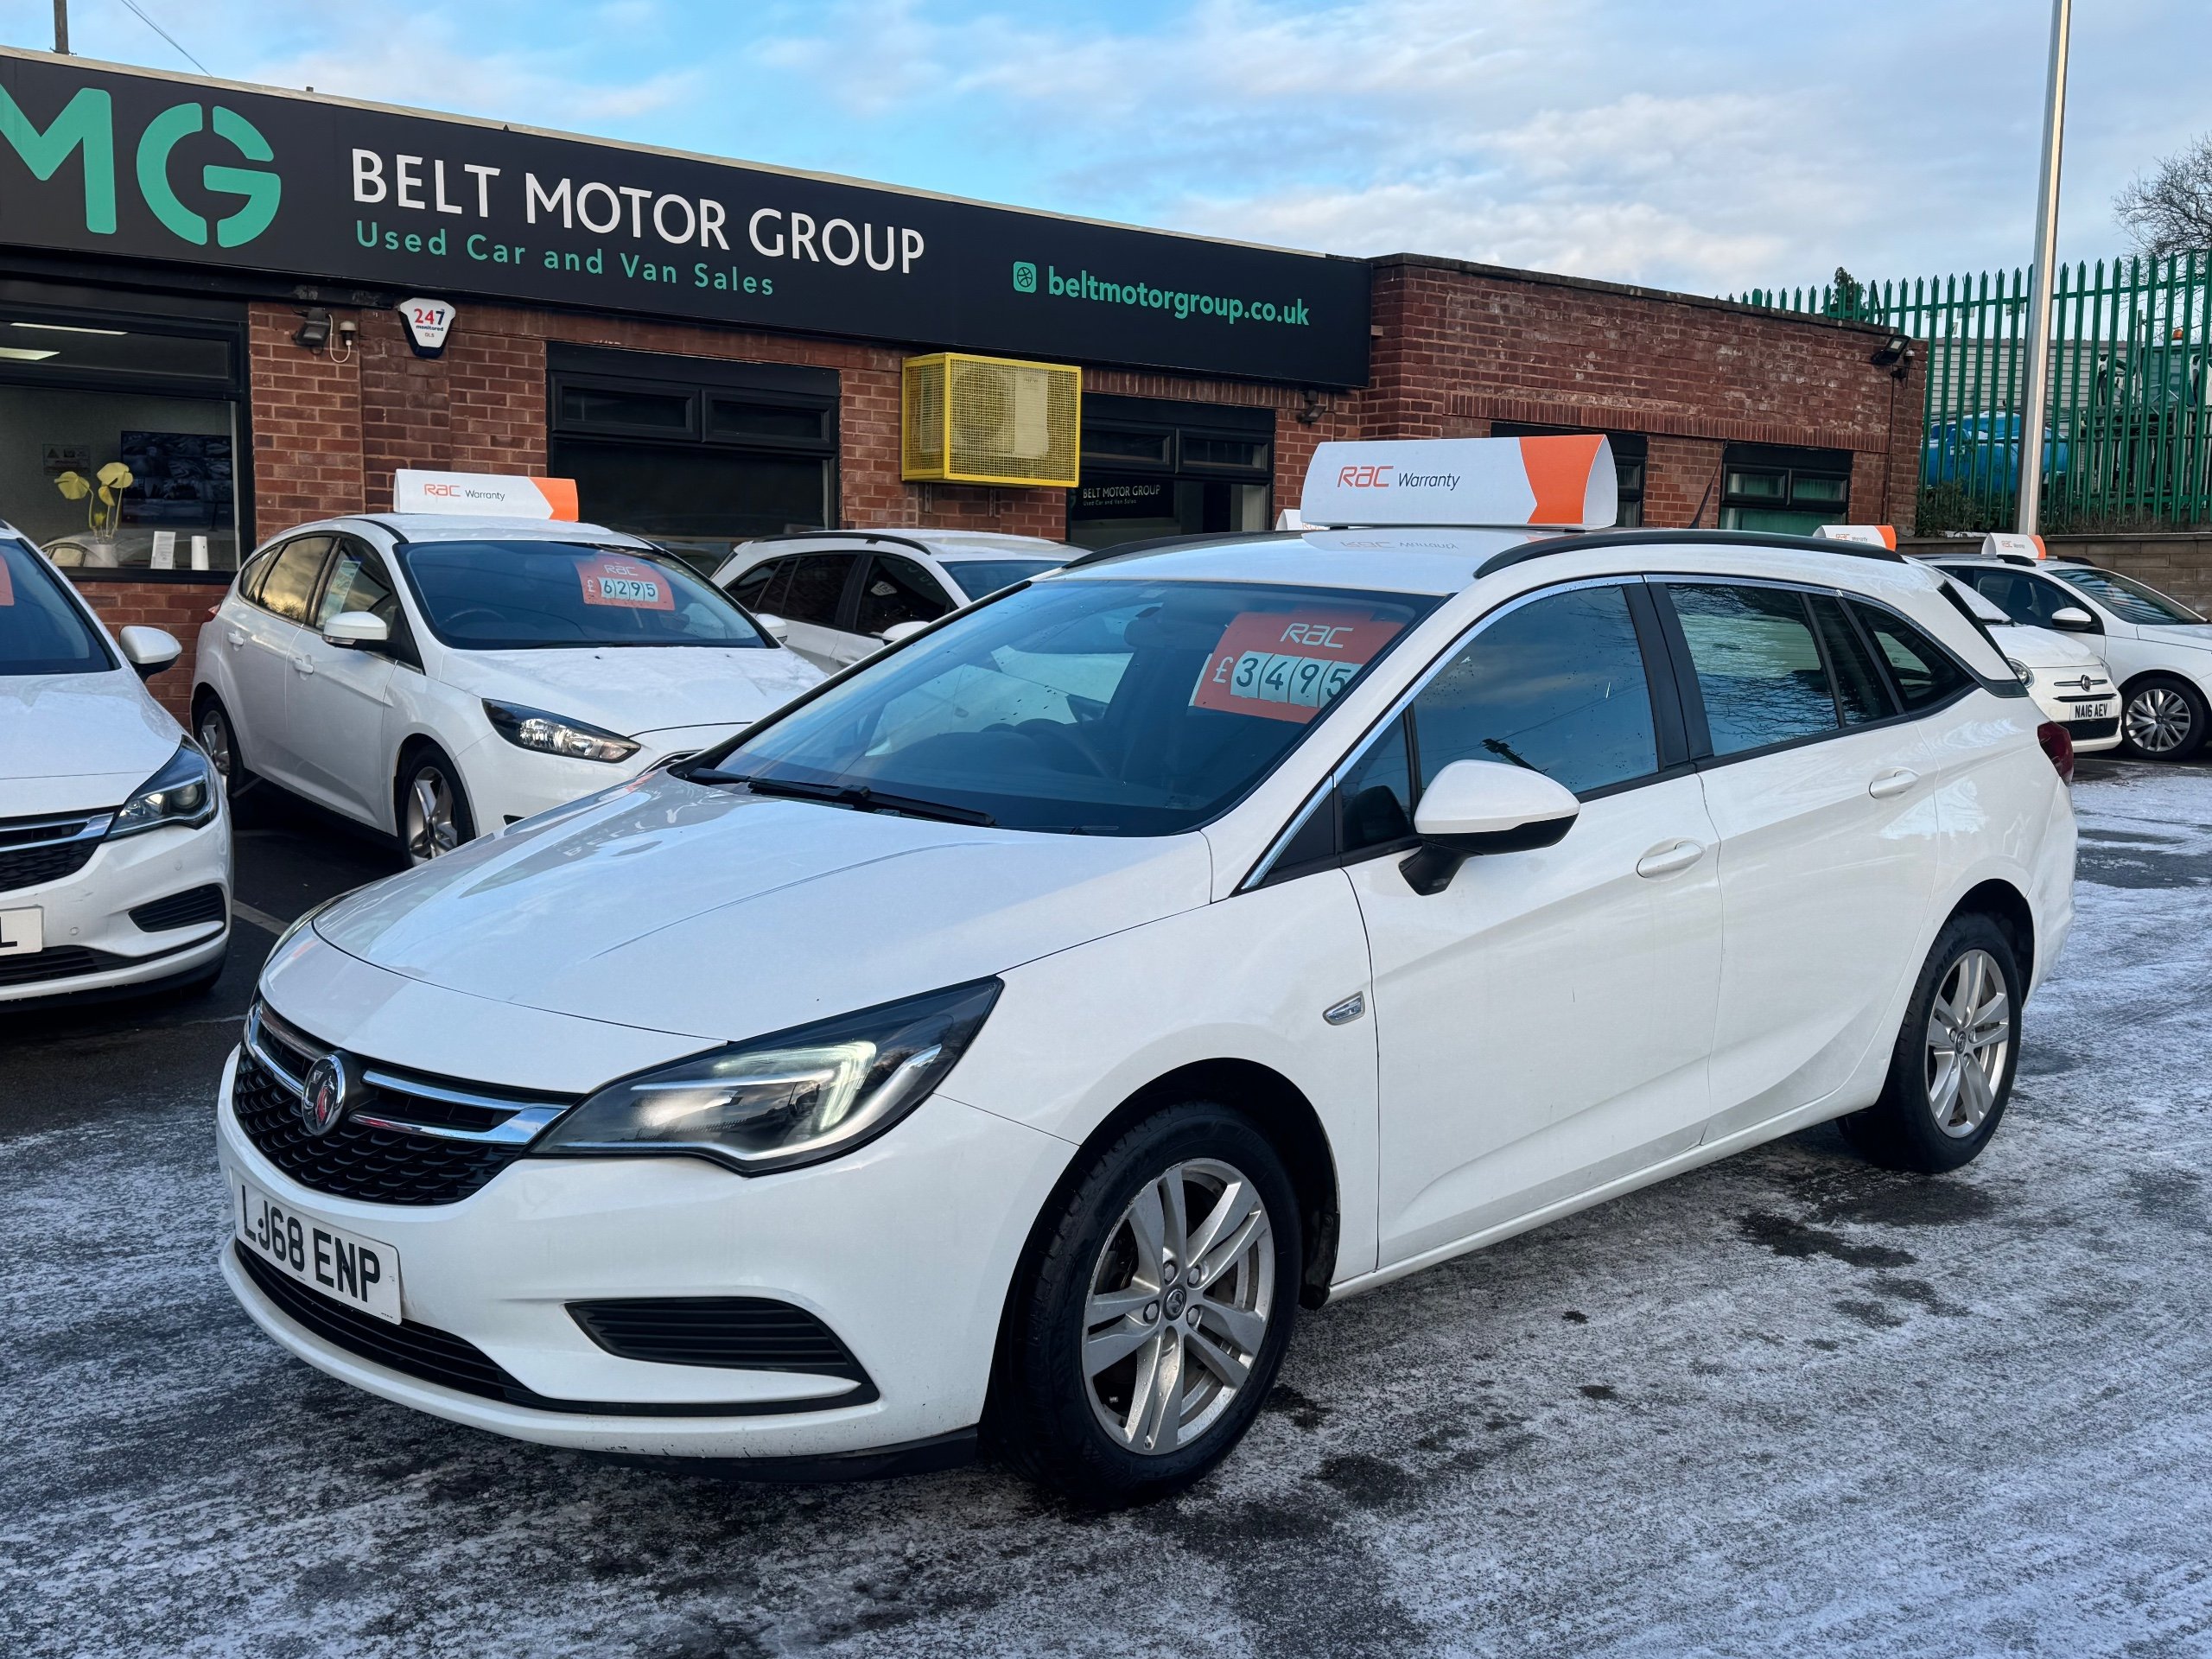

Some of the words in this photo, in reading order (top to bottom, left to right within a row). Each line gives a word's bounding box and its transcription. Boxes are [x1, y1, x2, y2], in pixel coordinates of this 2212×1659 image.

[352, 148, 501, 219] BELT
[525, 173, 730, 251] MOTOR
[748, 207, 925, 274] GROUP
[357, 219, 447, 256] Used
[467, 234, 525, 264] Car
[543, 249, 603, 275] and
[620, 252, 677, 283] Van
[694, 263, 773, 296] Sales
[1048, 265, 1310, 326] beltmotorgroup.co.uk
[414, 308, 445, 325] 247
[1399, 473, 1460, 491] Warranty
[465, 490, 505, 501] Warranty
[1083, 488, 1101, 499] BELT
[1103, 486, 1130, 498] MOTOR
[1132, 485, 1160, 496] GROUP
[2075, 704, 2093, 718] NA16
[2094, 703, 2107, 717] AEV
[241, 1184, 305, 1273] LJ68
[312, 1227, 380, 1303] ENP
